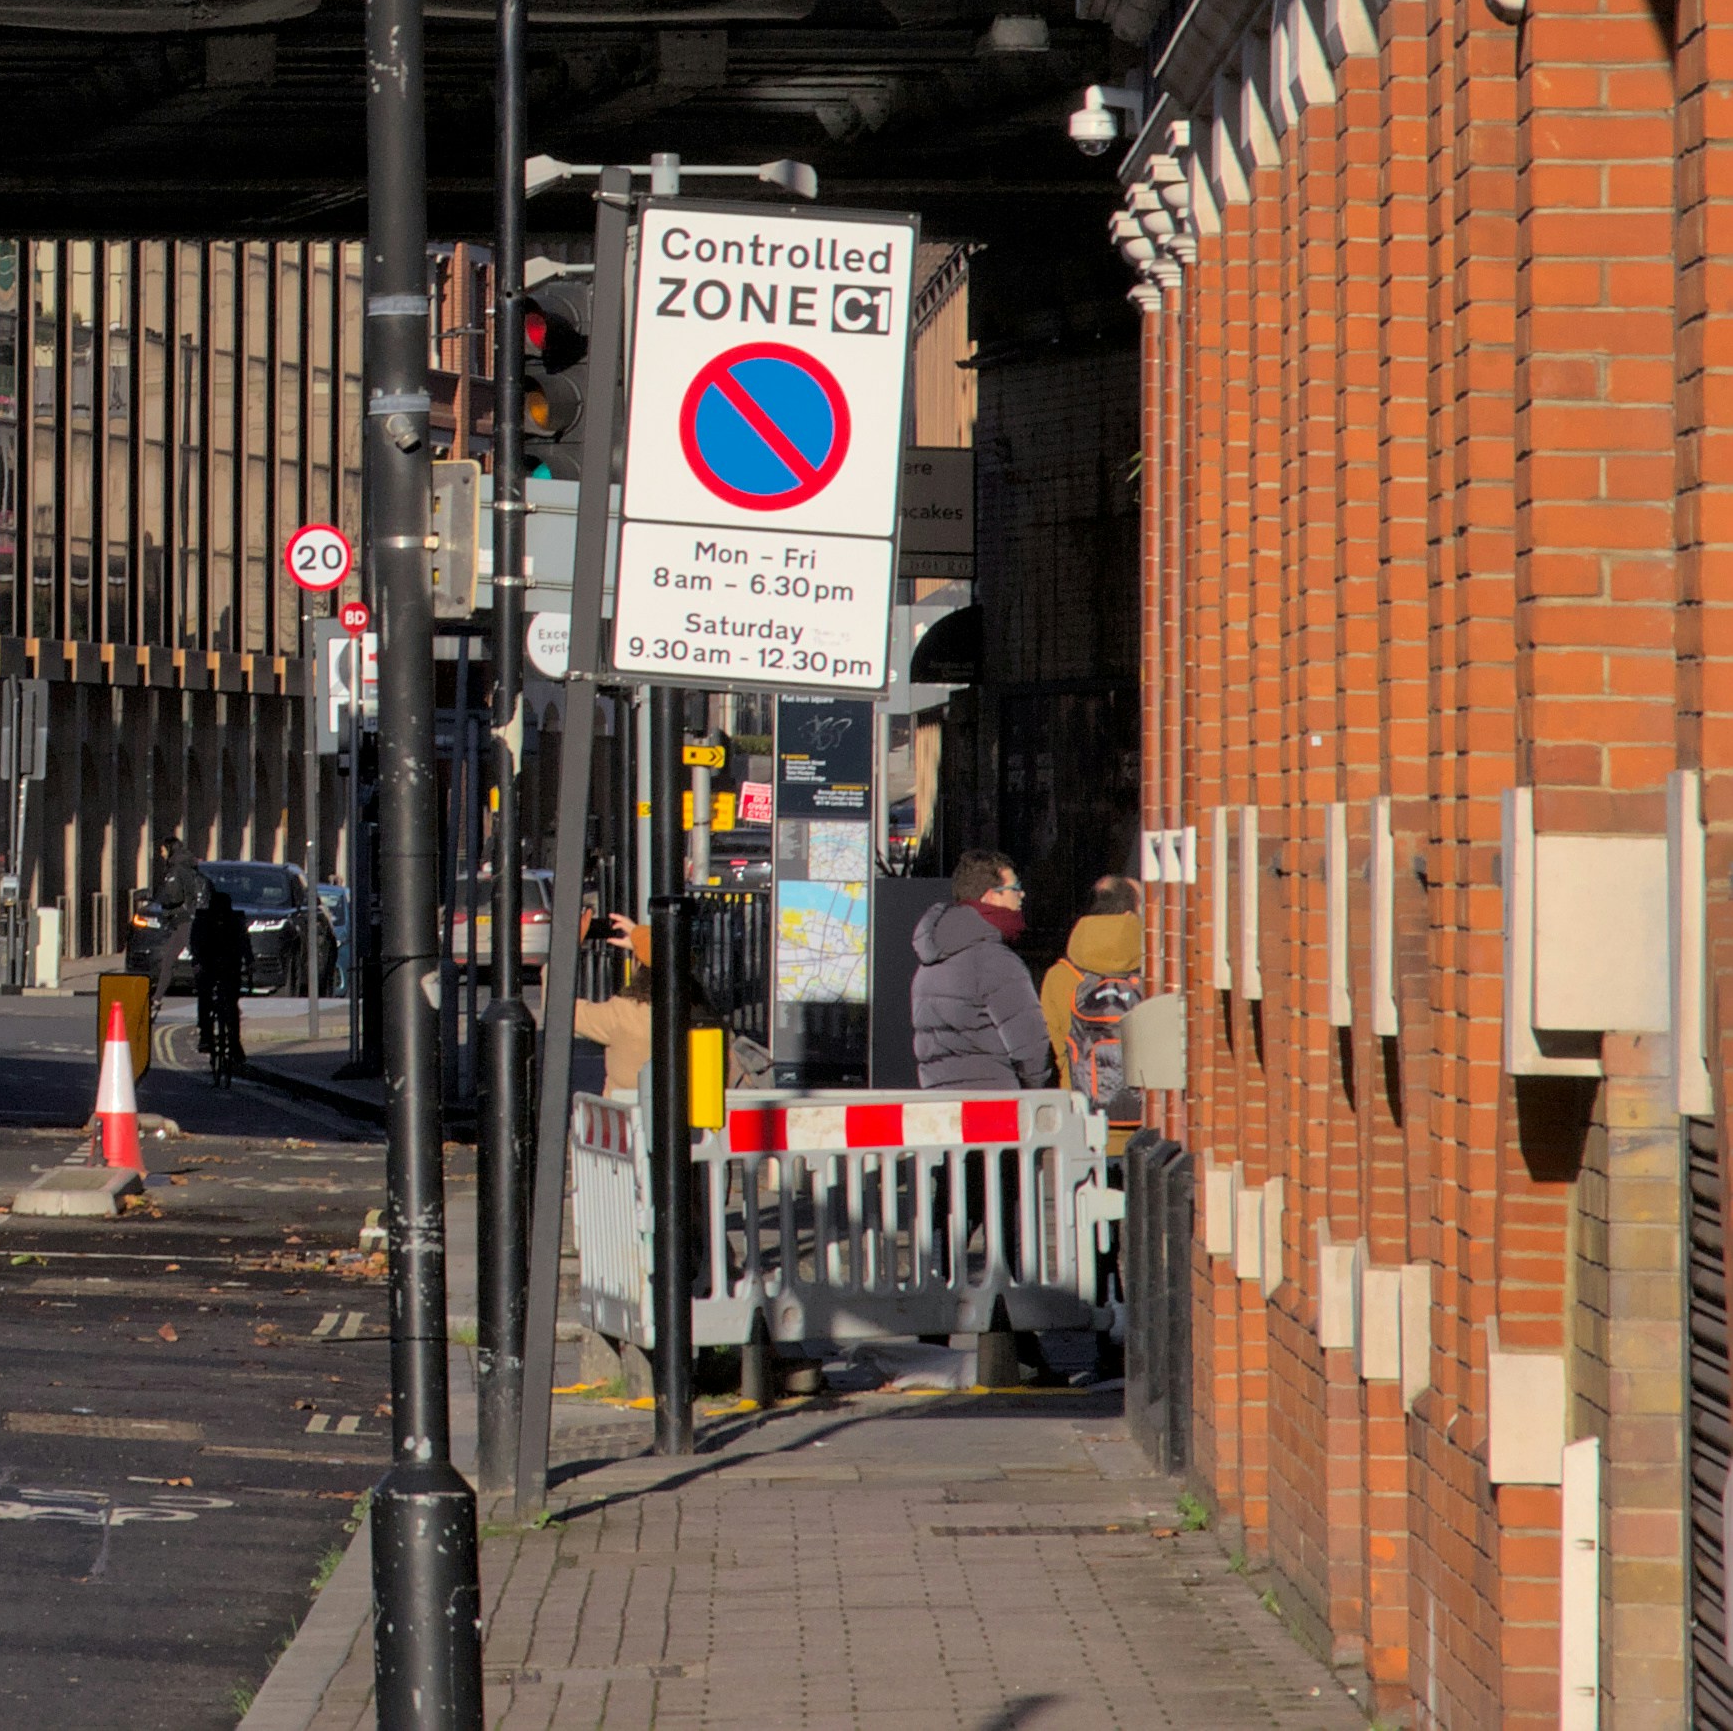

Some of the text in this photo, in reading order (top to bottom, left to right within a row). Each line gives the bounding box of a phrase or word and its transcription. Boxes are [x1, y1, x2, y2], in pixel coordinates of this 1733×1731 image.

[661, 227, 893, 275] Controlled
[656, 277, 893, 333] ZONE C1
[297, 544, 343, 571] 20
[694, 541, 749, 565] Mon
[784, 547, 817, 569] Fri
[344, 610, 367, 626] BD
[685, 612, 804, 645] Saturday
